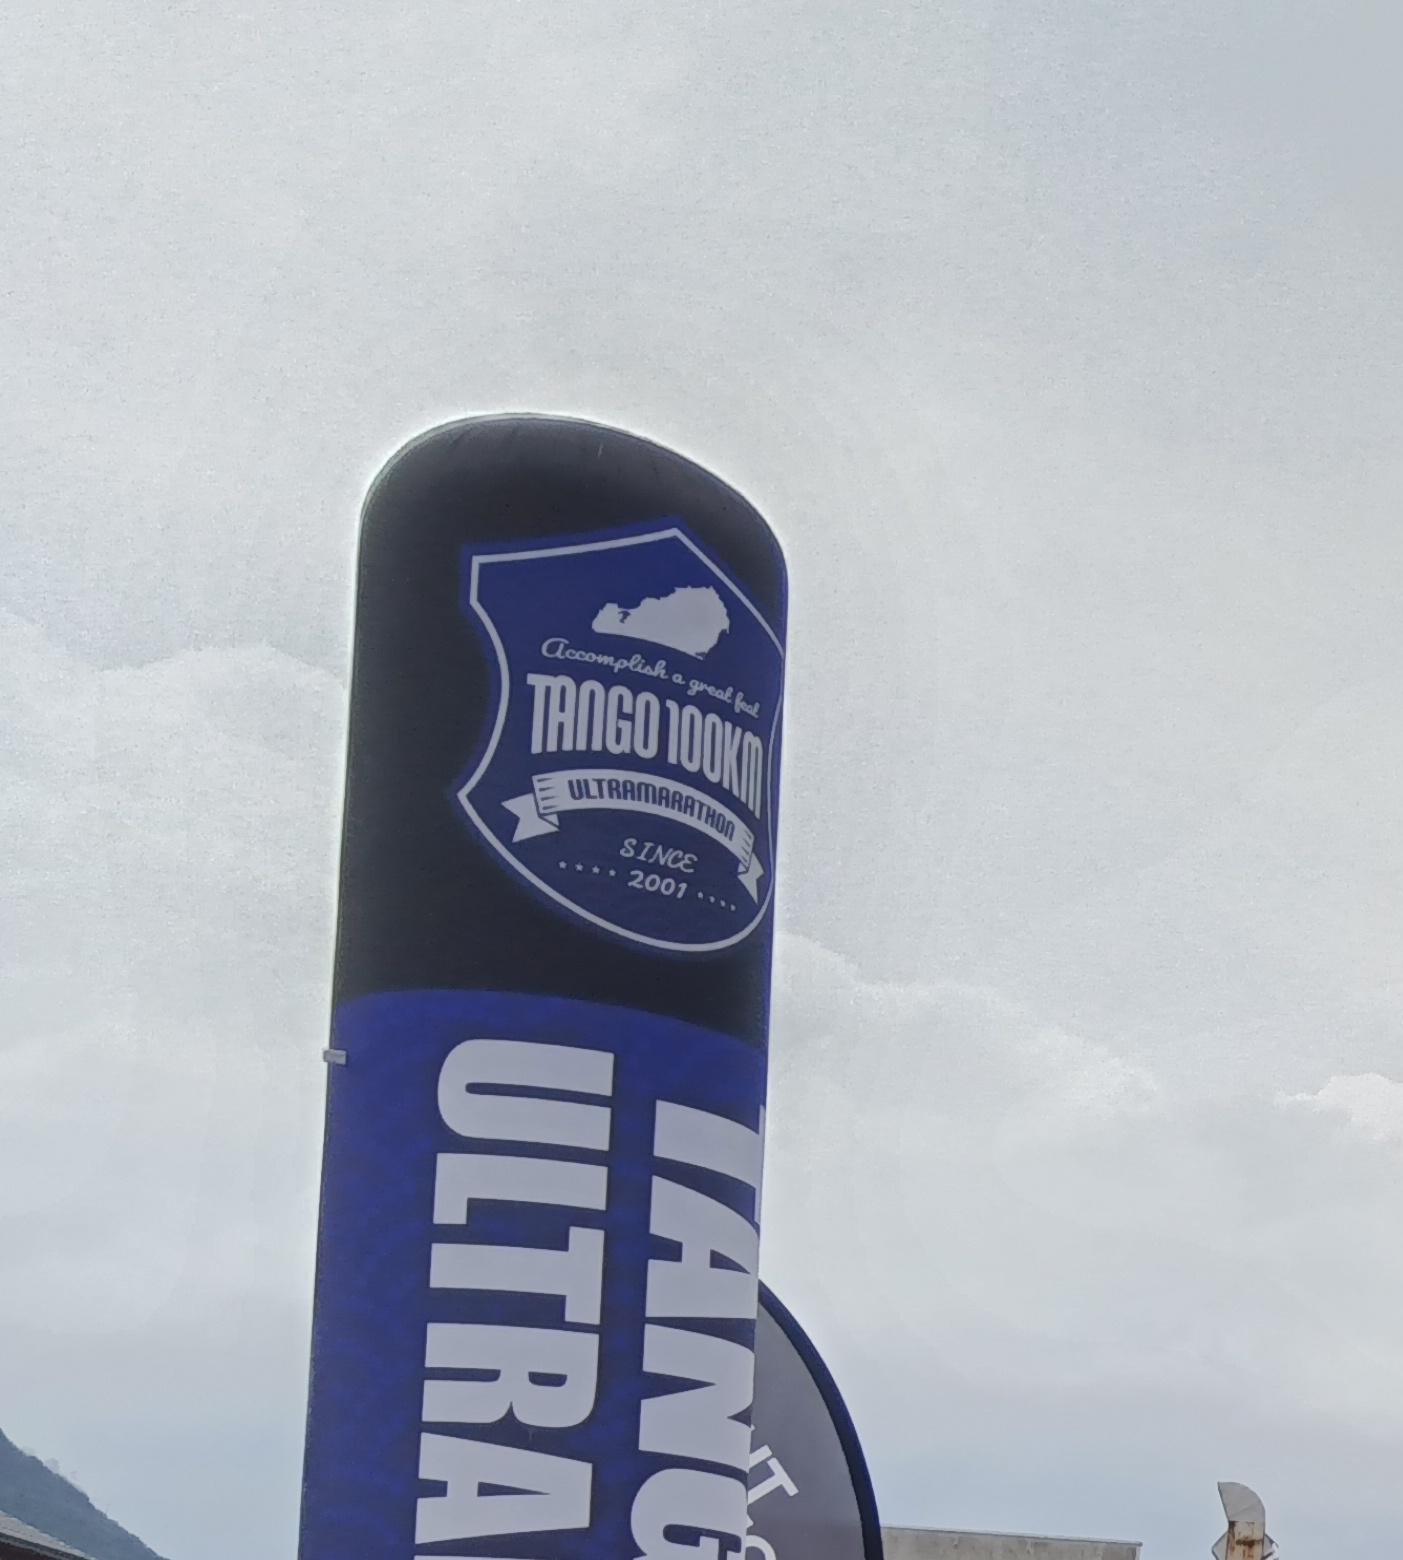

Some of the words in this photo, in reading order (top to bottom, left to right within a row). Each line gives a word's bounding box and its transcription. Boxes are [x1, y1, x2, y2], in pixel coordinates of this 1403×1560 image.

[540, 637, 668, 680] Accomplish
[672, 673, 685, 685] a
[689, 677, 734, 704] great
[527, 673, 660, 759] TANGO
[666, 700, 764, 819] 100KM
[568, 778, 735, 842] ULTRAMARATHON
[620, 838, 698, 873] SINCE
[627, 870, 688, 899] 2001
